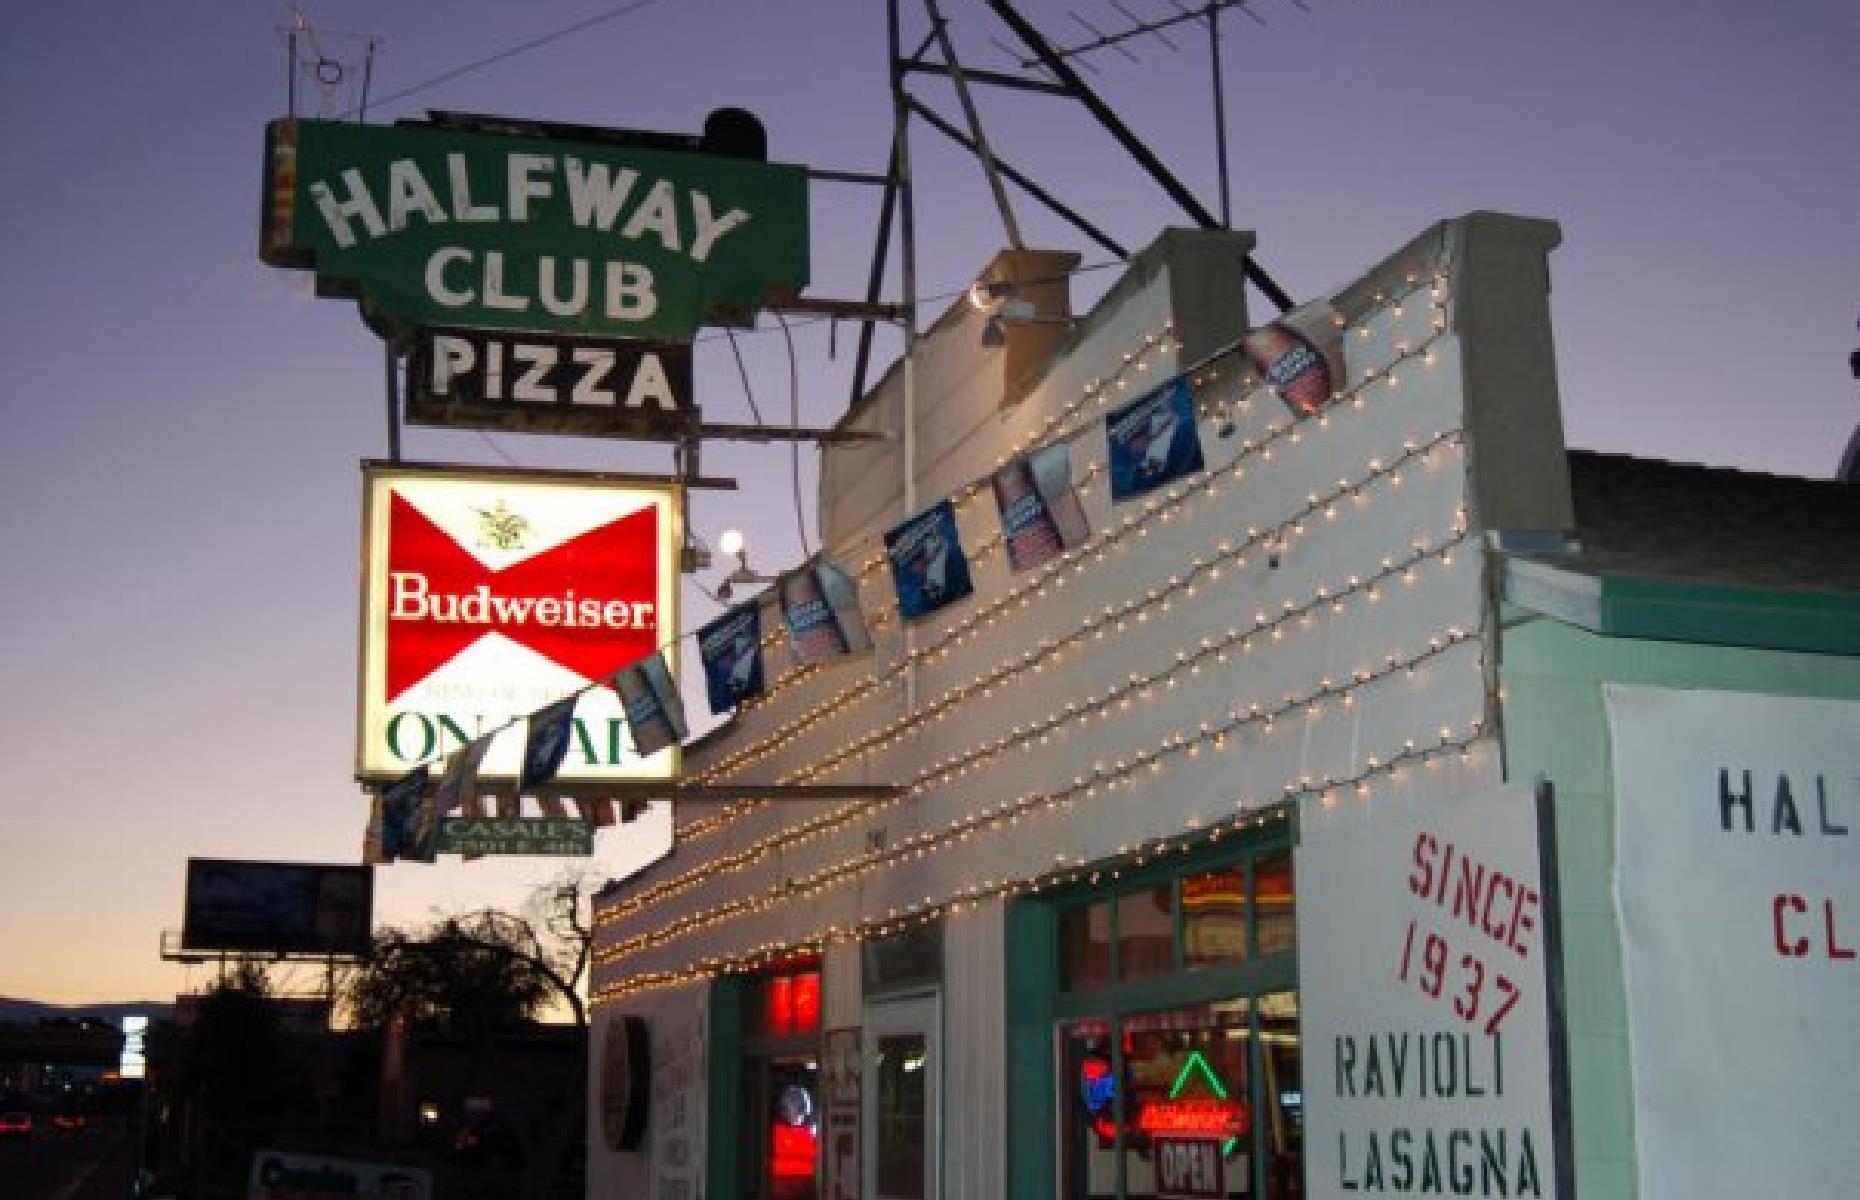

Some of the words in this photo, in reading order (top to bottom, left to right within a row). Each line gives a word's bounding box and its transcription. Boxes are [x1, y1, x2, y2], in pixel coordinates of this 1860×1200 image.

[310, 153, 751, 262] HALFWAY
[425, 246, 658, 321] CLUB
[433, 336, 676, 411] PIZZA
[1718, 767, 1849, 837] HAL
[1410, 832, 1537, 958] SINCE
[1773, 894, 1857, 958] CL
[1400, 918, 1522, 1035] 1937
[1335, 1031, 1503, 1098] RAVIOLI
[1339, 1127, 1540, 1198] LASAGNA
